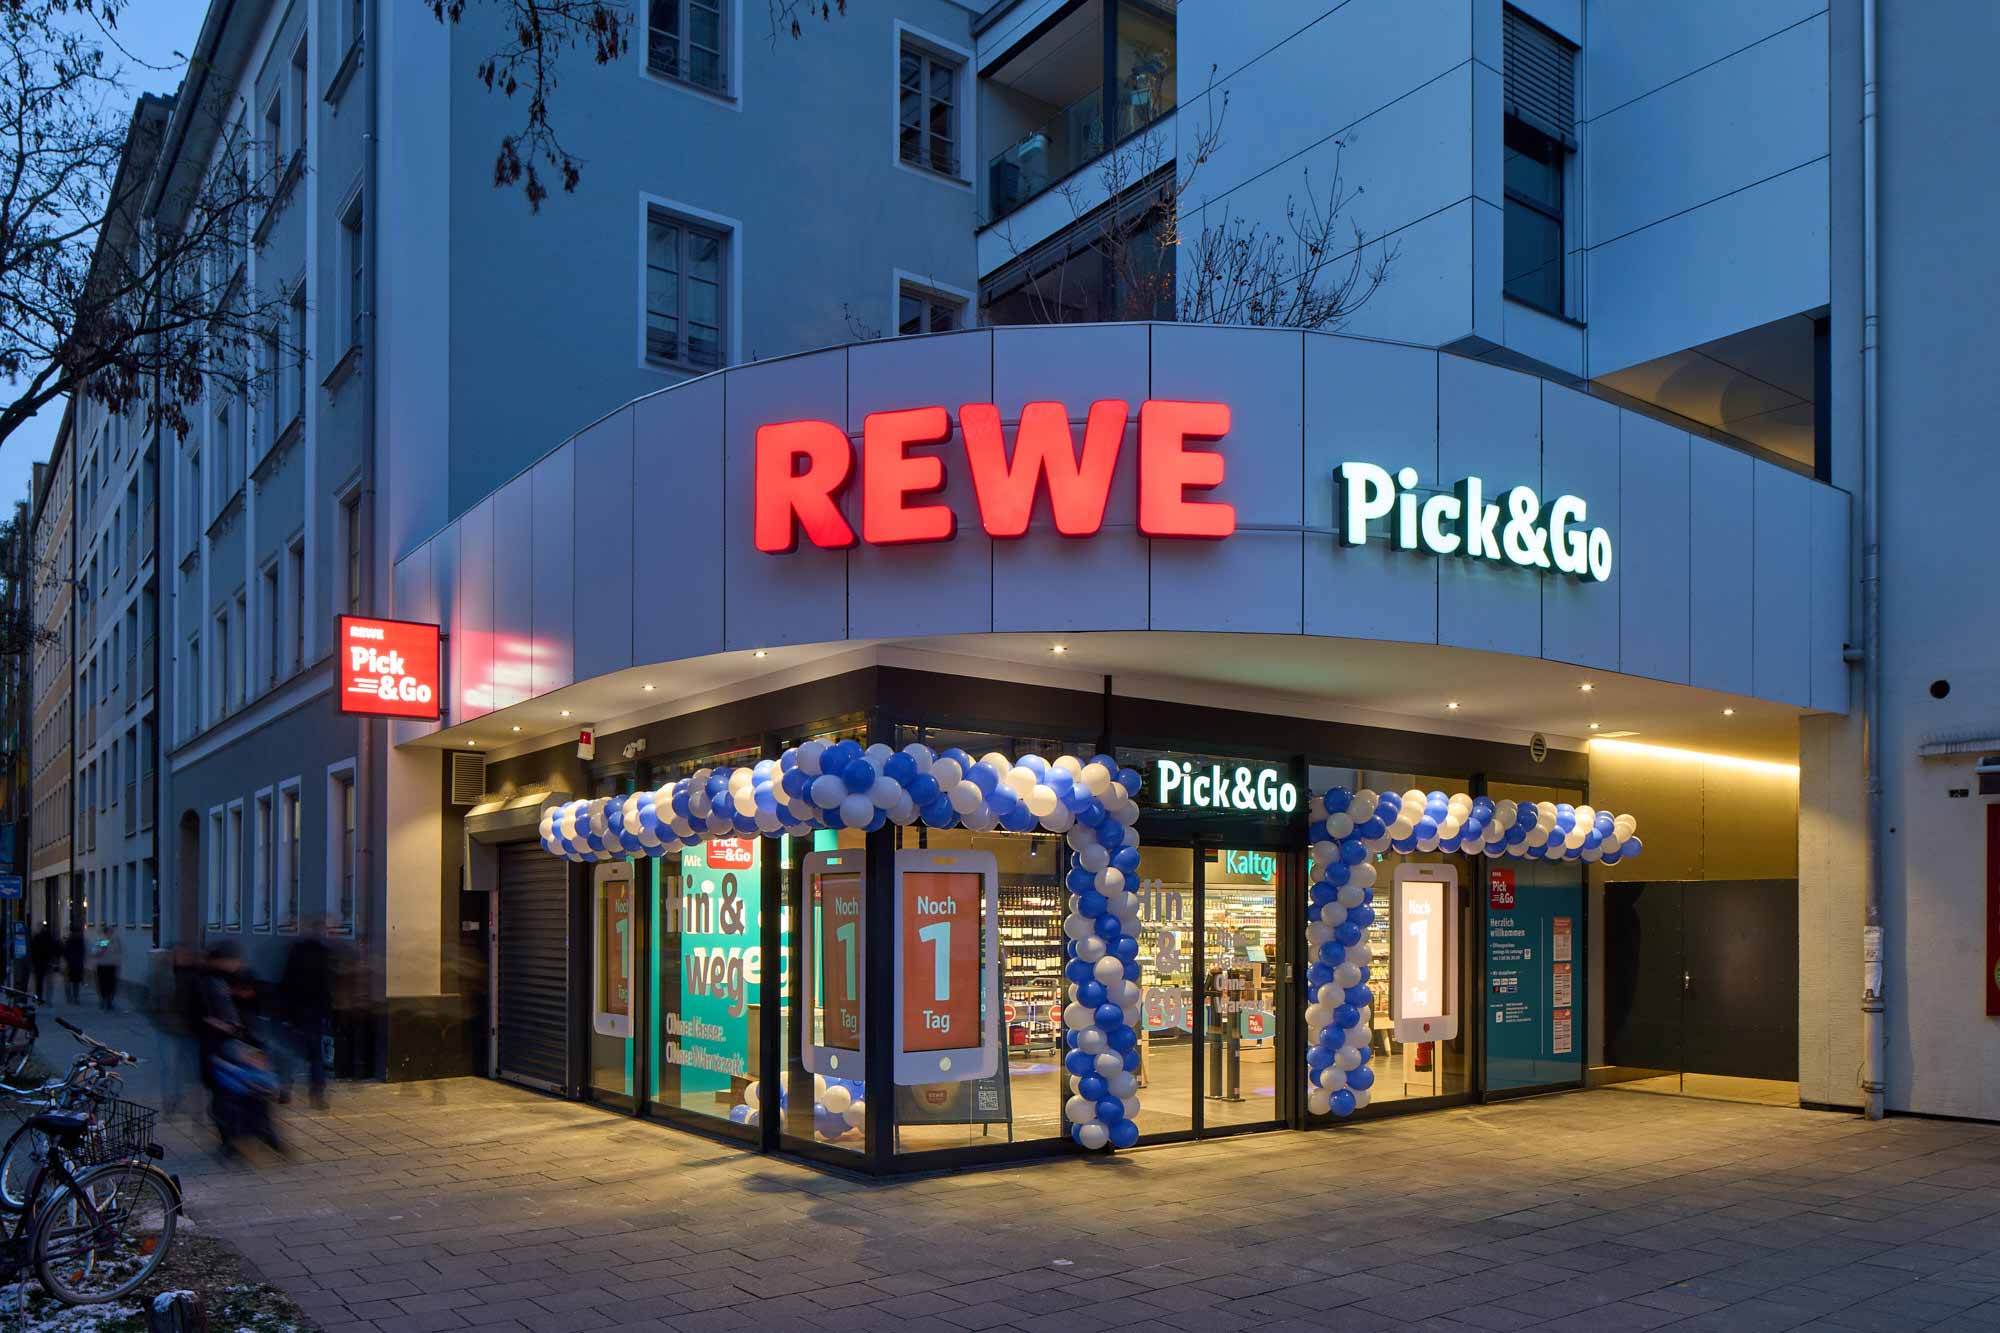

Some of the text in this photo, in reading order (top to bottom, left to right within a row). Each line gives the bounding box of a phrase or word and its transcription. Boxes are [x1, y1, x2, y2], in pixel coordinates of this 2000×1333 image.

[755, 399, 1236, 553] REWE
[1339, 461, 1613, 583] Pick&Go
[350, 646, 405, 675] Pick
[378, 675, 432, 703] &Go
[1157, 759, 1297, 812] Pick&Go
[684, 854, 702, 867] Mit
[724, 847, 752, 863] &Go
[1492, 881, 1507, 892] Pick
[1499, 893, 1514, 904] &Go
[615, 899, 629, 913] Noc
[835, 897, 859, 915] Noch
[916, 896, 957, 915] Noch
[836, 922, 857, 1001] 1
[918, 921, 951, 1001] 1
[1408, 918, 1429, 982] 1
[685, 954, 745, 1018] weg
[840, 1008, 858, 1033] Tag
[923, 1009, 951, 1033] Tag
